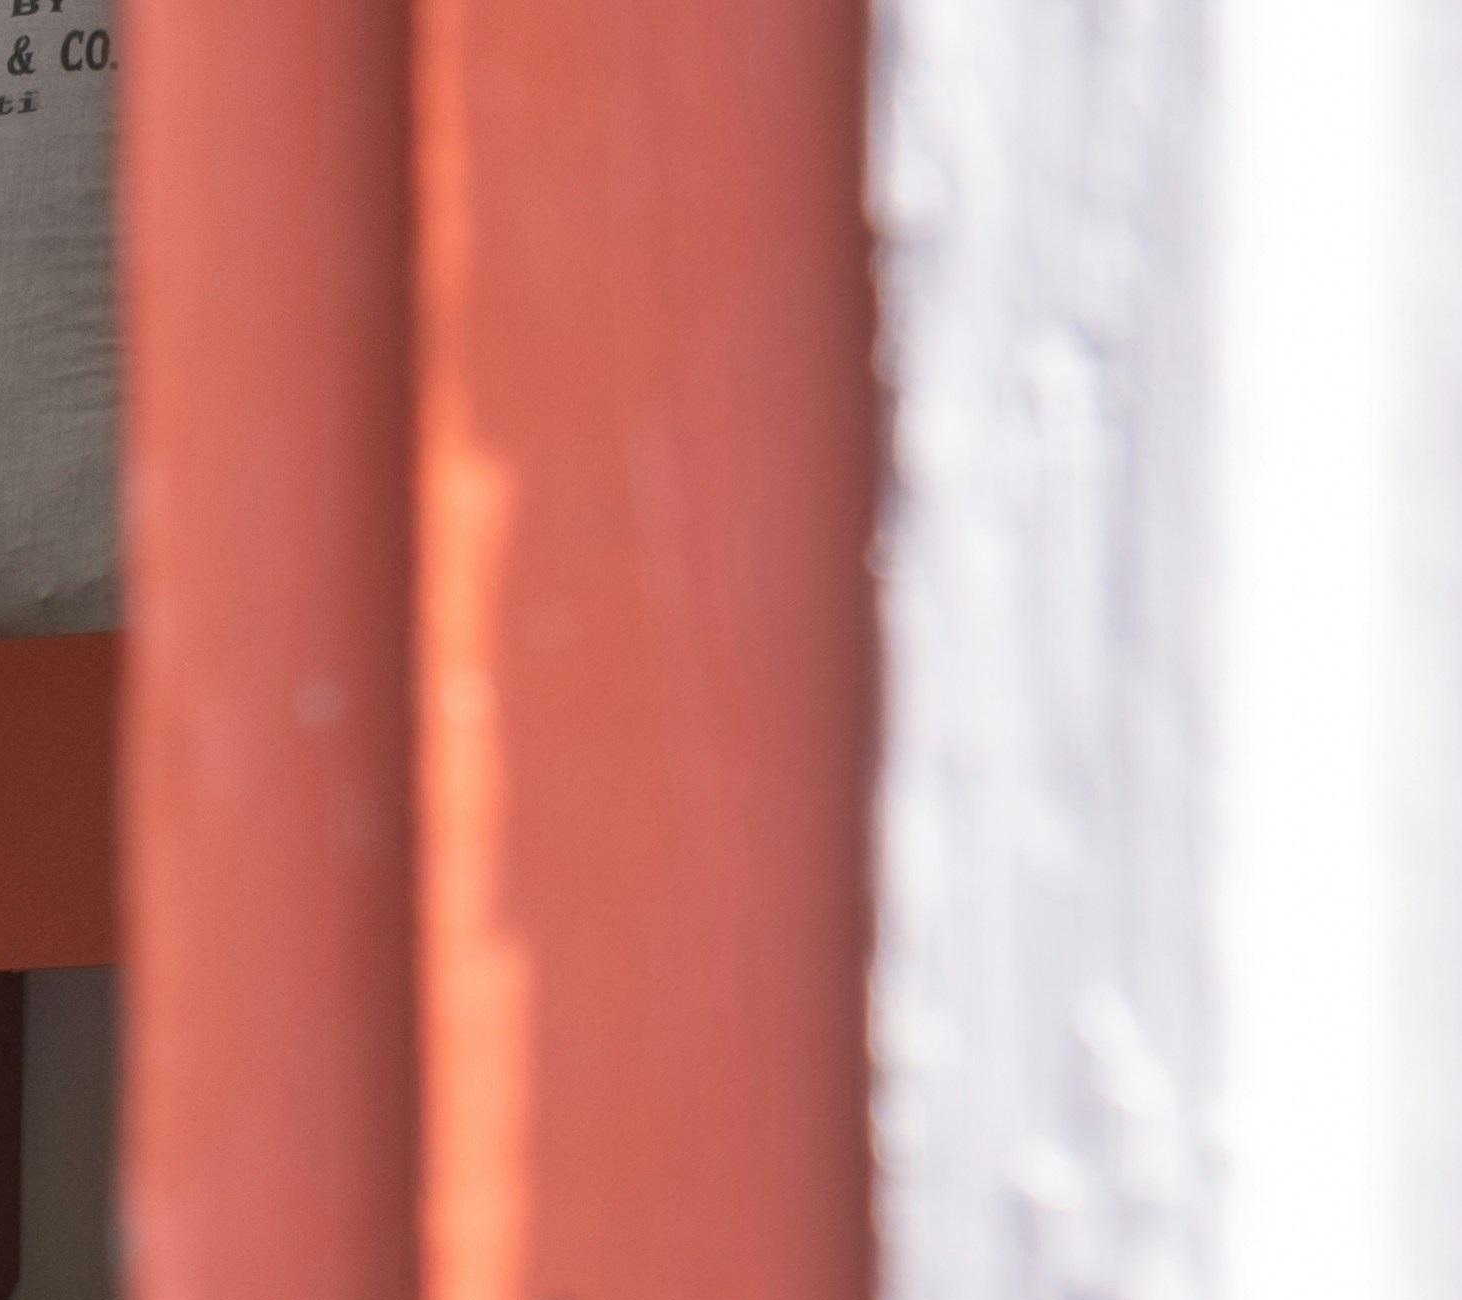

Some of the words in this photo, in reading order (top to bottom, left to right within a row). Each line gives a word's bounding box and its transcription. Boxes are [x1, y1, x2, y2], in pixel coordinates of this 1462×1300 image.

[11, 0, 64, 16] BY
[7, 35, 36, 76] &
[60, 30, 119, 72] CO.
